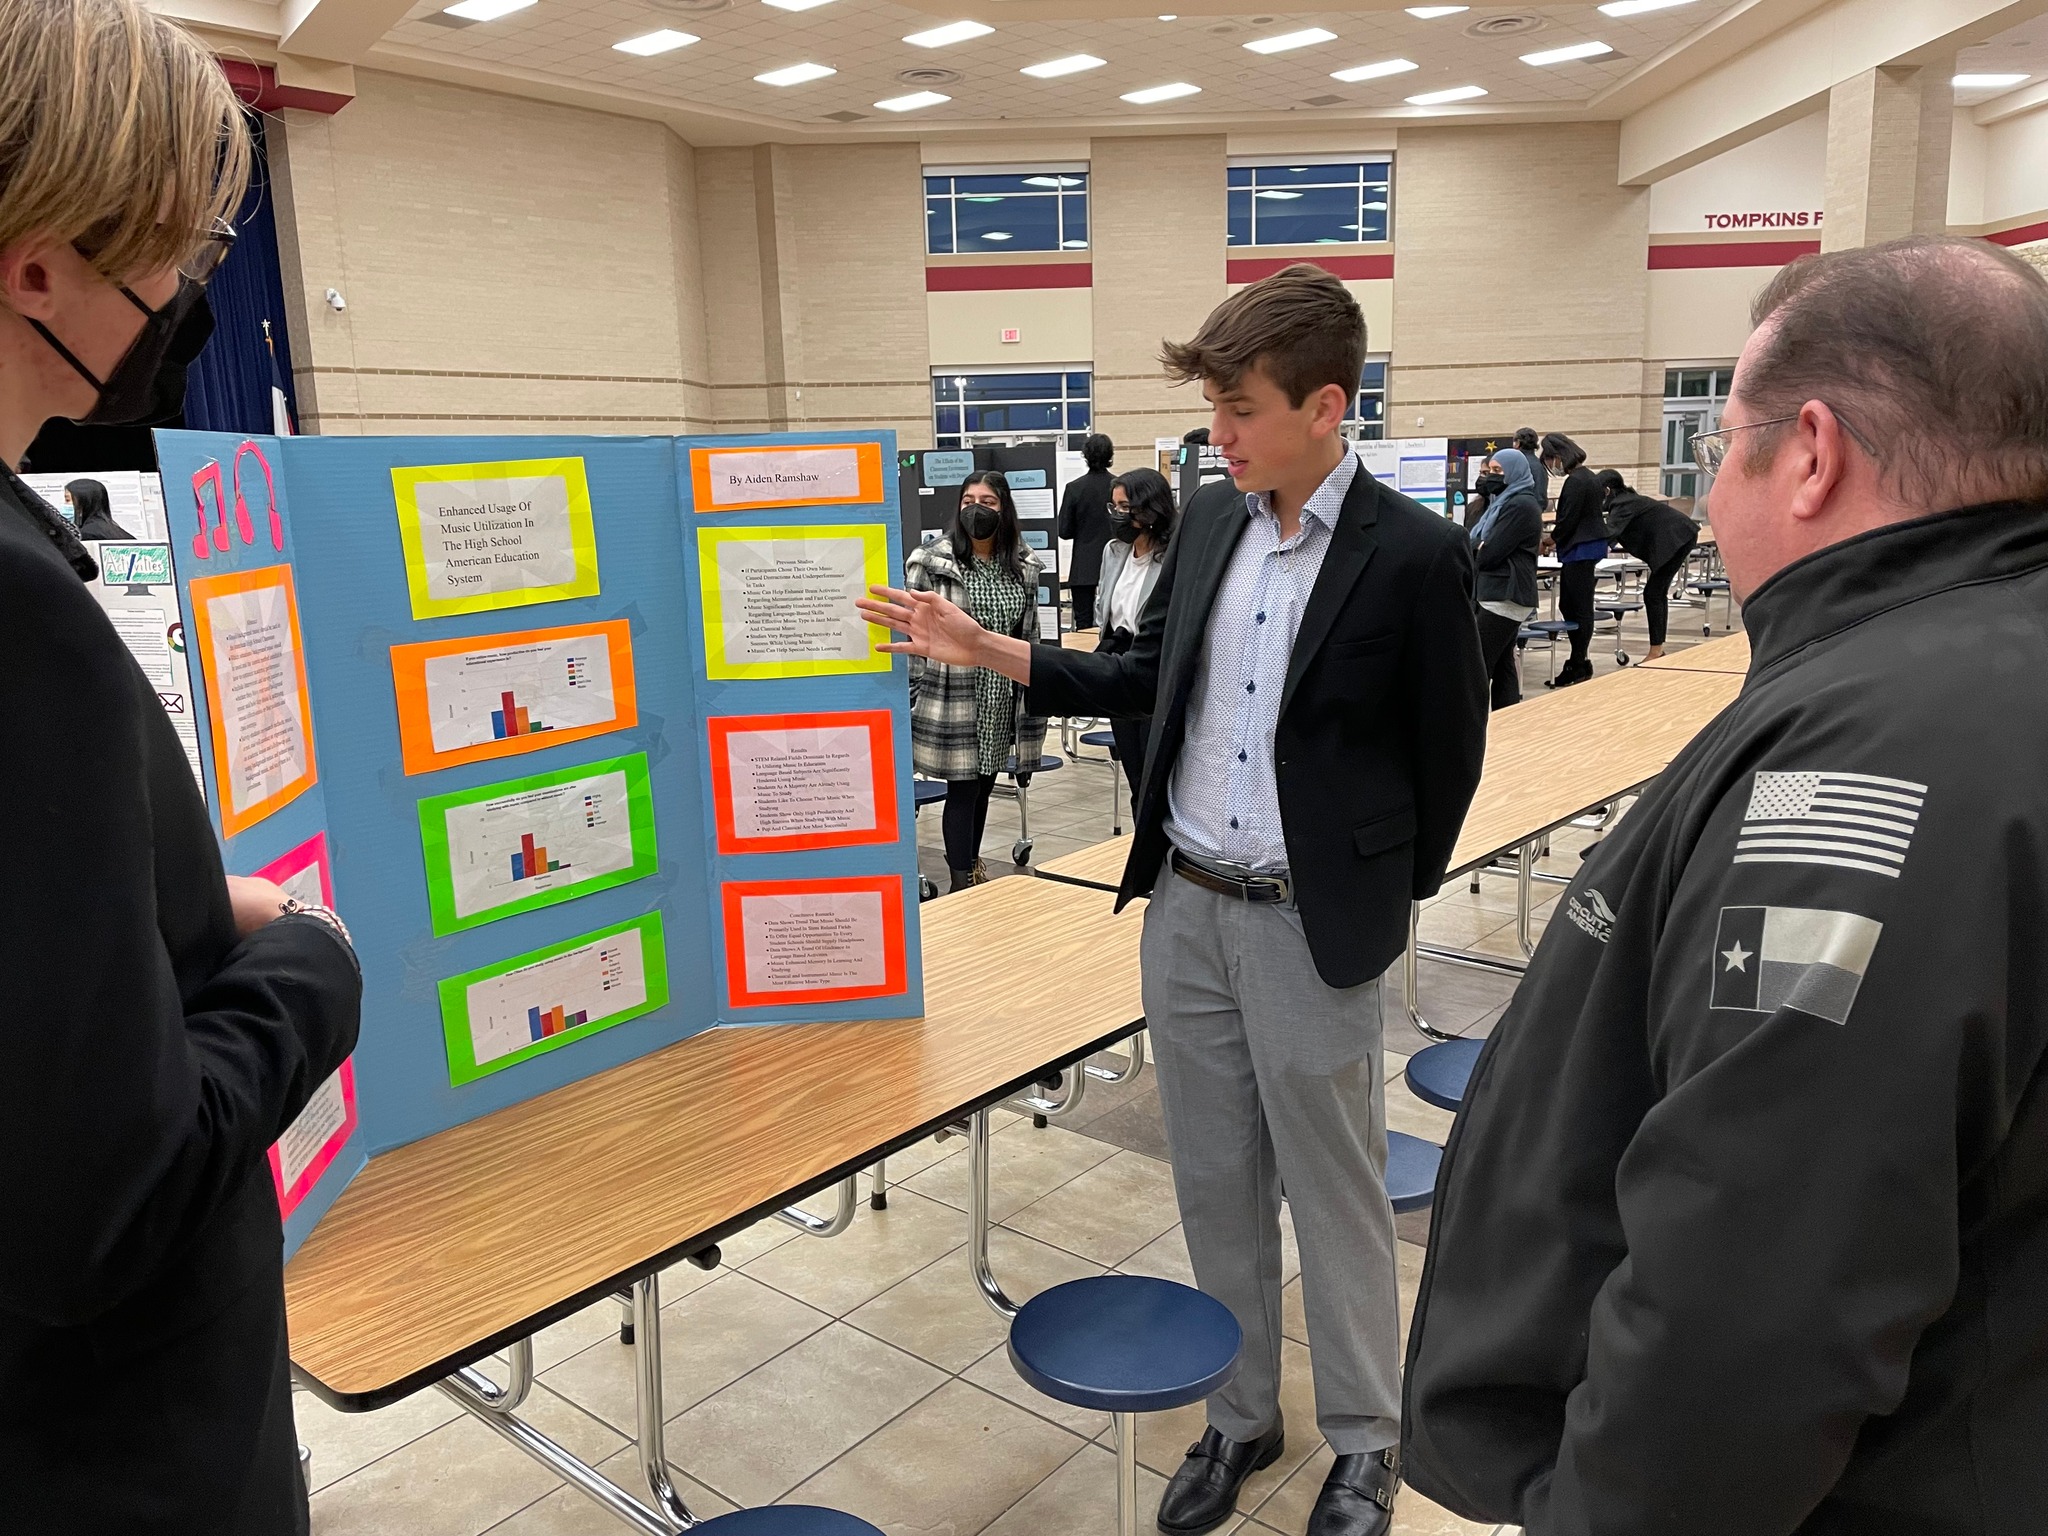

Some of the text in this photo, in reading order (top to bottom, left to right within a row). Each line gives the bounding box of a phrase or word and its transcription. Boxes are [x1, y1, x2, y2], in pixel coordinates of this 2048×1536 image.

[1704, 212, 1809, 228] TOMPKINS
[729, 473, 819, 486] By Aiden Ramshaw
[439, 502, 532, 517] Enhanced Usage Of
[441, 519, 534, 534] Music Utilization In
[442, 535, 522, 551] The High School
[445, 551, 540, 568] American Education
[447, 573, 482, 587] System
